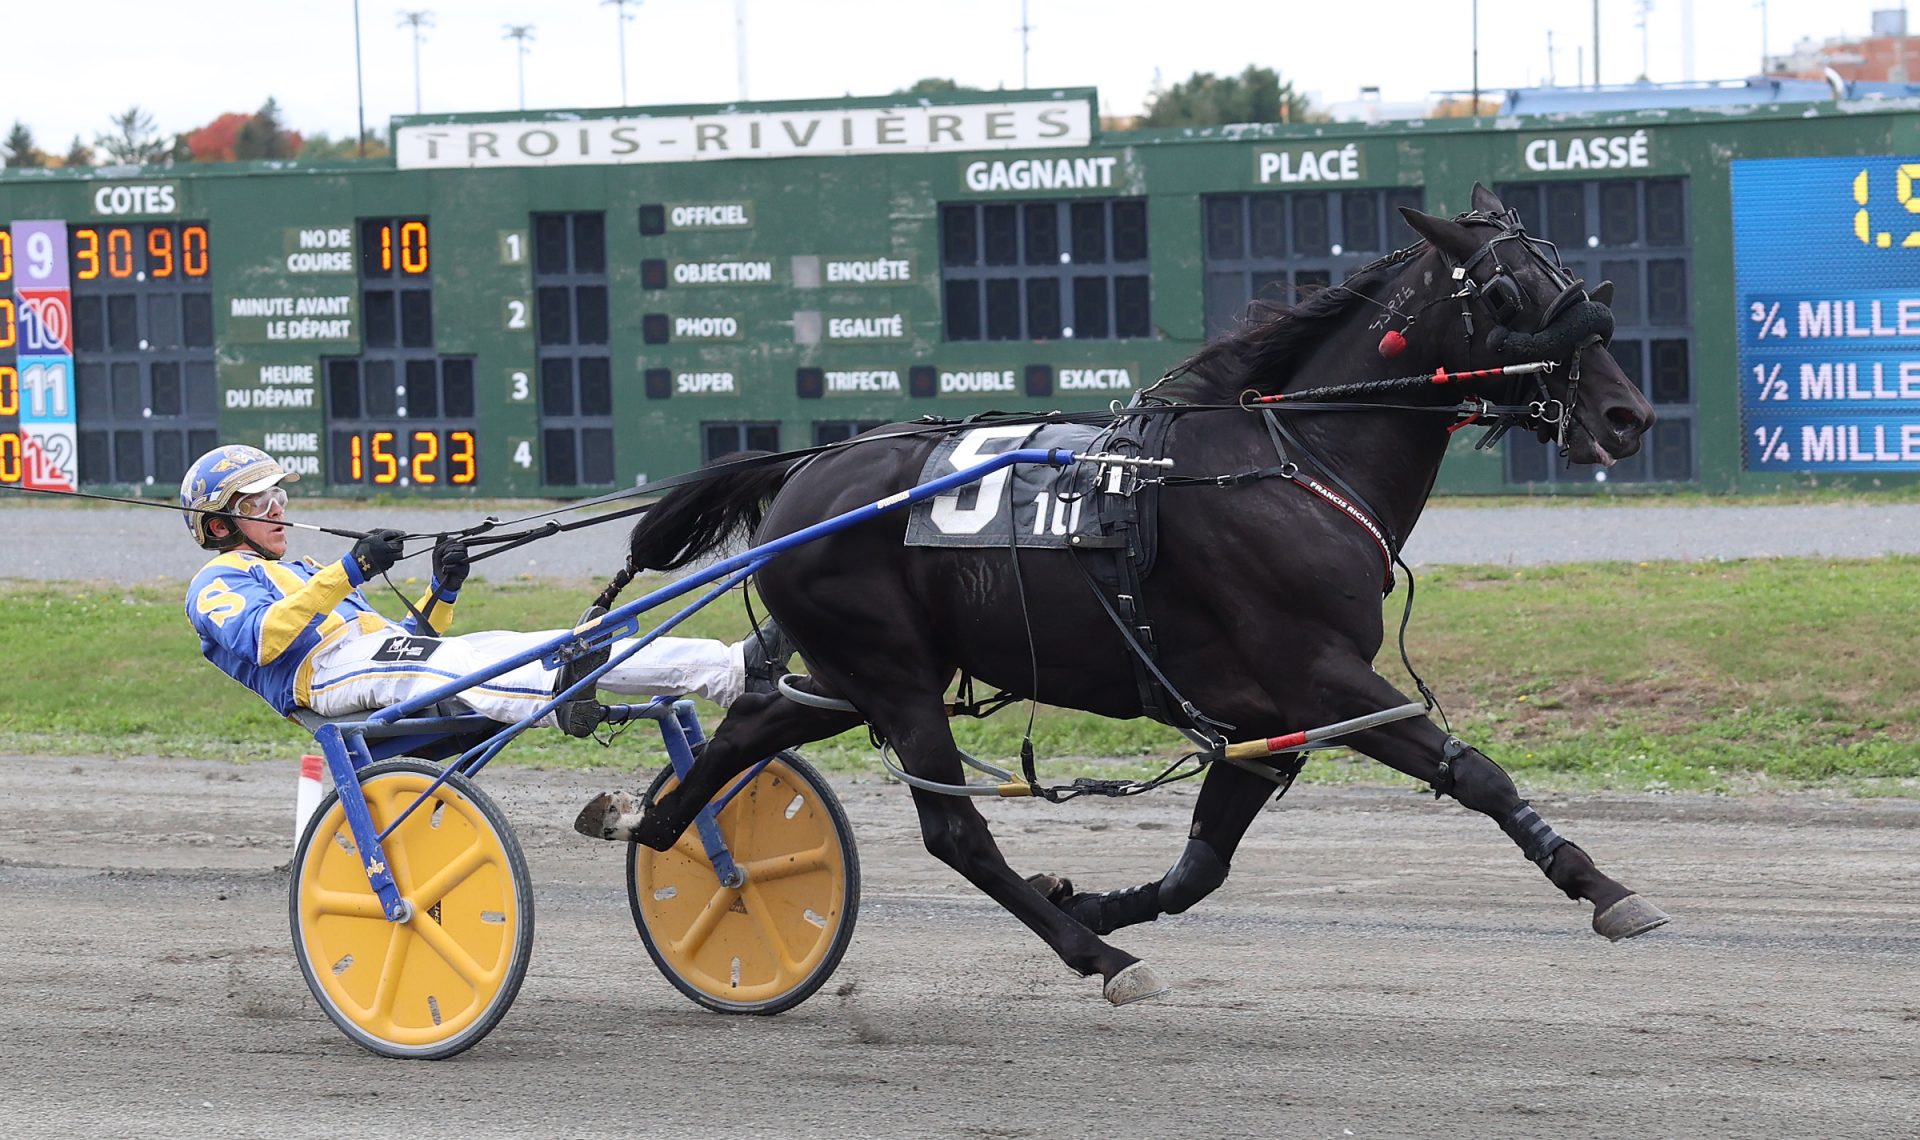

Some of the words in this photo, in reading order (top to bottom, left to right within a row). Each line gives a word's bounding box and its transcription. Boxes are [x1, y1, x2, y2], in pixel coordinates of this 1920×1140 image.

[415, 108, 1070, 159] TROIS-RIVIÈRES
[1260, 144, 1359, 183] PLACÉ
[1525, 130, 1649, 171] CLASSÉ
[966, 157, 1117, 191] GAGNANT
[95, 185, 176, 214] COTES
[672, 205, 748, 227] OFFICIEL
[300, 229, 326, 248] NO
[327, 229, 351, 248] DE
[380, 221, 429, 274] 10
[506, 234, 520, 260] 1
[27, 231, 54, 279] 9
[287, 252, 352, 272] COURSE
[674, 262, 771, 283] OBJECTION
[827, 258, 910, 283] ENQUÊTE
[231, 298, 294, 317] MINUTE
[295, 296, 350, 315] AVANT
[508, 301, 526, 329] 2
[1799, 299, 1920, 337] MILLE
[19, 296, 69, 350] 10
[267, 321, 287, 340] LE
[288, 316, 351, 339] DÉPART
[675, 317, 737, 337] PHOTO
[829, 314, 903, 338] EGALITÉ
[260, 365, 314, 384] HEURE
[512, 372, 529, 400] 3
[677, 372, 734, 392] SUPER
[825, 370, 901, 391] TRIFECTA
[940, 370, 1015, 392] DOUBLE
[1059, 369, 1131, 389] EXACTA
[1800, 361, 1920, 400] MILLE
[22, 363, 69, 417] 11
[226, 389, 250, 408] DU
[252, 385, 315, 408] DÉPART
[264, 433, 318, 452] HEURE
[514, 440, 532, 468] 4
[1801, 423, 1920, 462] MILLE
[23, 433, 74, 486] 12
[930, 423, 1047, 534] 5
[1032, 492, 1082, 535] 10
[1309, 481, 1348, 509] FRANCIS
[1346, 505, 1382, 539] RICHARD
[197, 577, 247, 629] S
